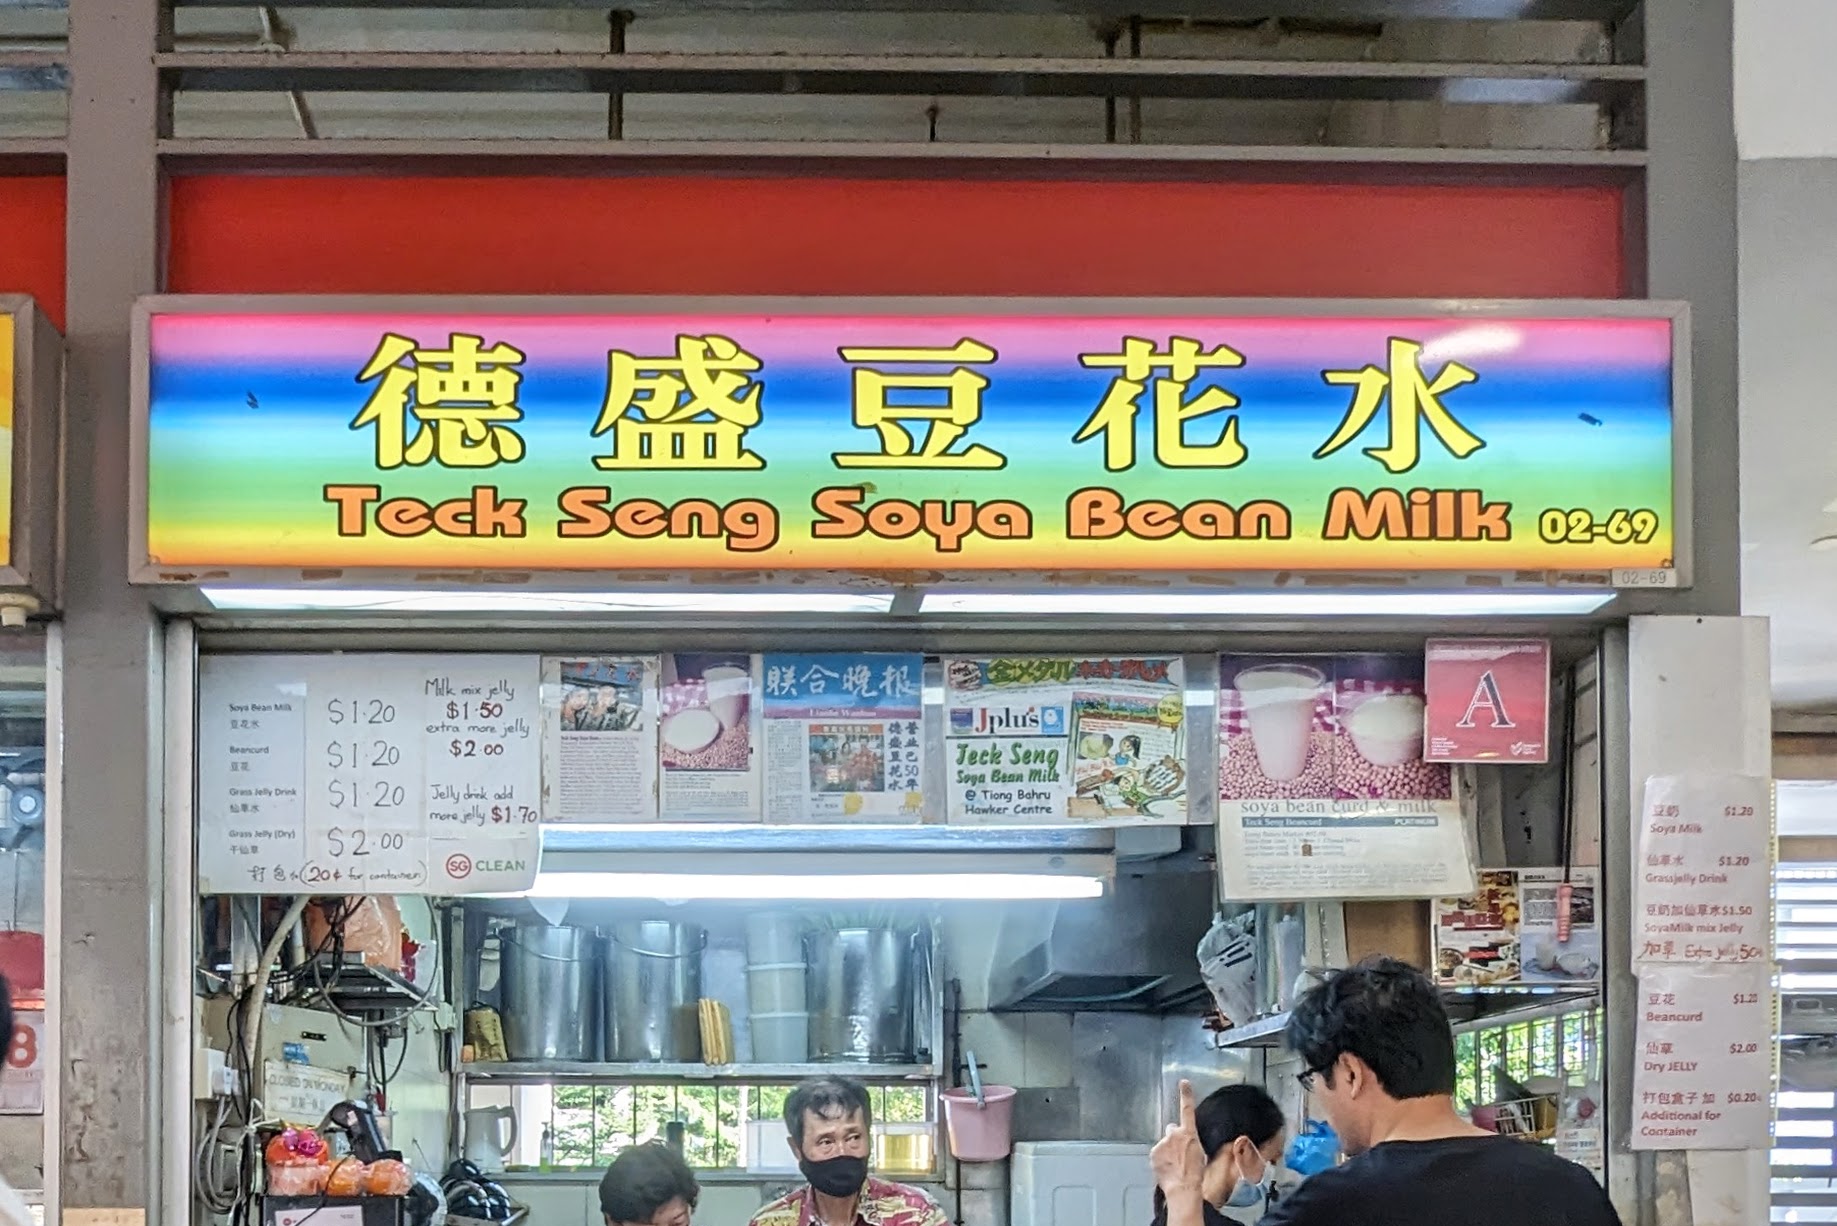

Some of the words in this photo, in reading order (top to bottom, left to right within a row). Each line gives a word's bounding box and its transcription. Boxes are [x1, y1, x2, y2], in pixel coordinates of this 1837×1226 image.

[349, 333, 1486, 470] 德盛豆花水
[323, 484, 527, 539] Teck
[557, 485, 780, 553] Seng
[811, 486, 1034, 552] Soya
[1065, 486, 1292, 541] Bean
[1321, 488, 1513, 541] Milk
[1537, 508, 1660, 546] 02-69
[1621, 570, 1668, 585] 02-69
[425, 677, 456, 697] Milk
[461, 684, 482, 695] mix
[485, 679, 515, 701] jelly
[1456, 670, 1516, 728] A
[426, 721, 460, 734] extra
[467, 725, 497, 734] more
[500, 717, 530, 738] jelly
[229, 745, 270, 755] Beancurd
[956, 742, 1003, 766] Teck
[1009, 742, 1060, 769] Seng
[956, 769, 986, 787] Soya
[991, 768, 1024, 783] Bean
[1028, 768, 1060, 783] Milk
[274, 787, 297, 797] Drink
[430, 783, 460, 804] Jelly
[462, 783, 488, 801] drink
[493, 784, 514, 801] add
[965, 789, 977, 801] @
[981, 789, 1013, 803] Tiong
[1017, 788, 1051, 801] Bahru
[965, 804, 1009, 815] Hawker
[1013, 804, 1053, 815] Centre
[1241, 801, 1280, 818] soya
[1285, 799, 1325, 814] bean
[1397, 799, 1437, 813] milk
[1724, 806, 1754, 817] $1.20
[430, 811, 458, 822] more
[460, 804, 486, 827] jelly
[1650, 823, 1676, 836] Soya
[1678, 823, 1703, 834] Milk
[449, 860, 469, 872] SG
[475, 860, 526, 872] CLEAN
[1718, 856, 1750, 867] $1.20
[349, 866, 364, 881] for
[1699, 873, 1728, 884] Drink
[1648, 993, 1676, 1006] 豆花
[1646, 1011, 1703, 1022] Beancurd
[1730, 1043, 1757, 1054] $2.00
[1644, 1062, 1665, 1073] Dry
[1667, 1062, 1698, 1072] JELLY
[1641, 1110, 1701, 1121] Additional
[1705, 1110, 1722, 1121] for
[1641, 1126, 1698, 1138] Container
